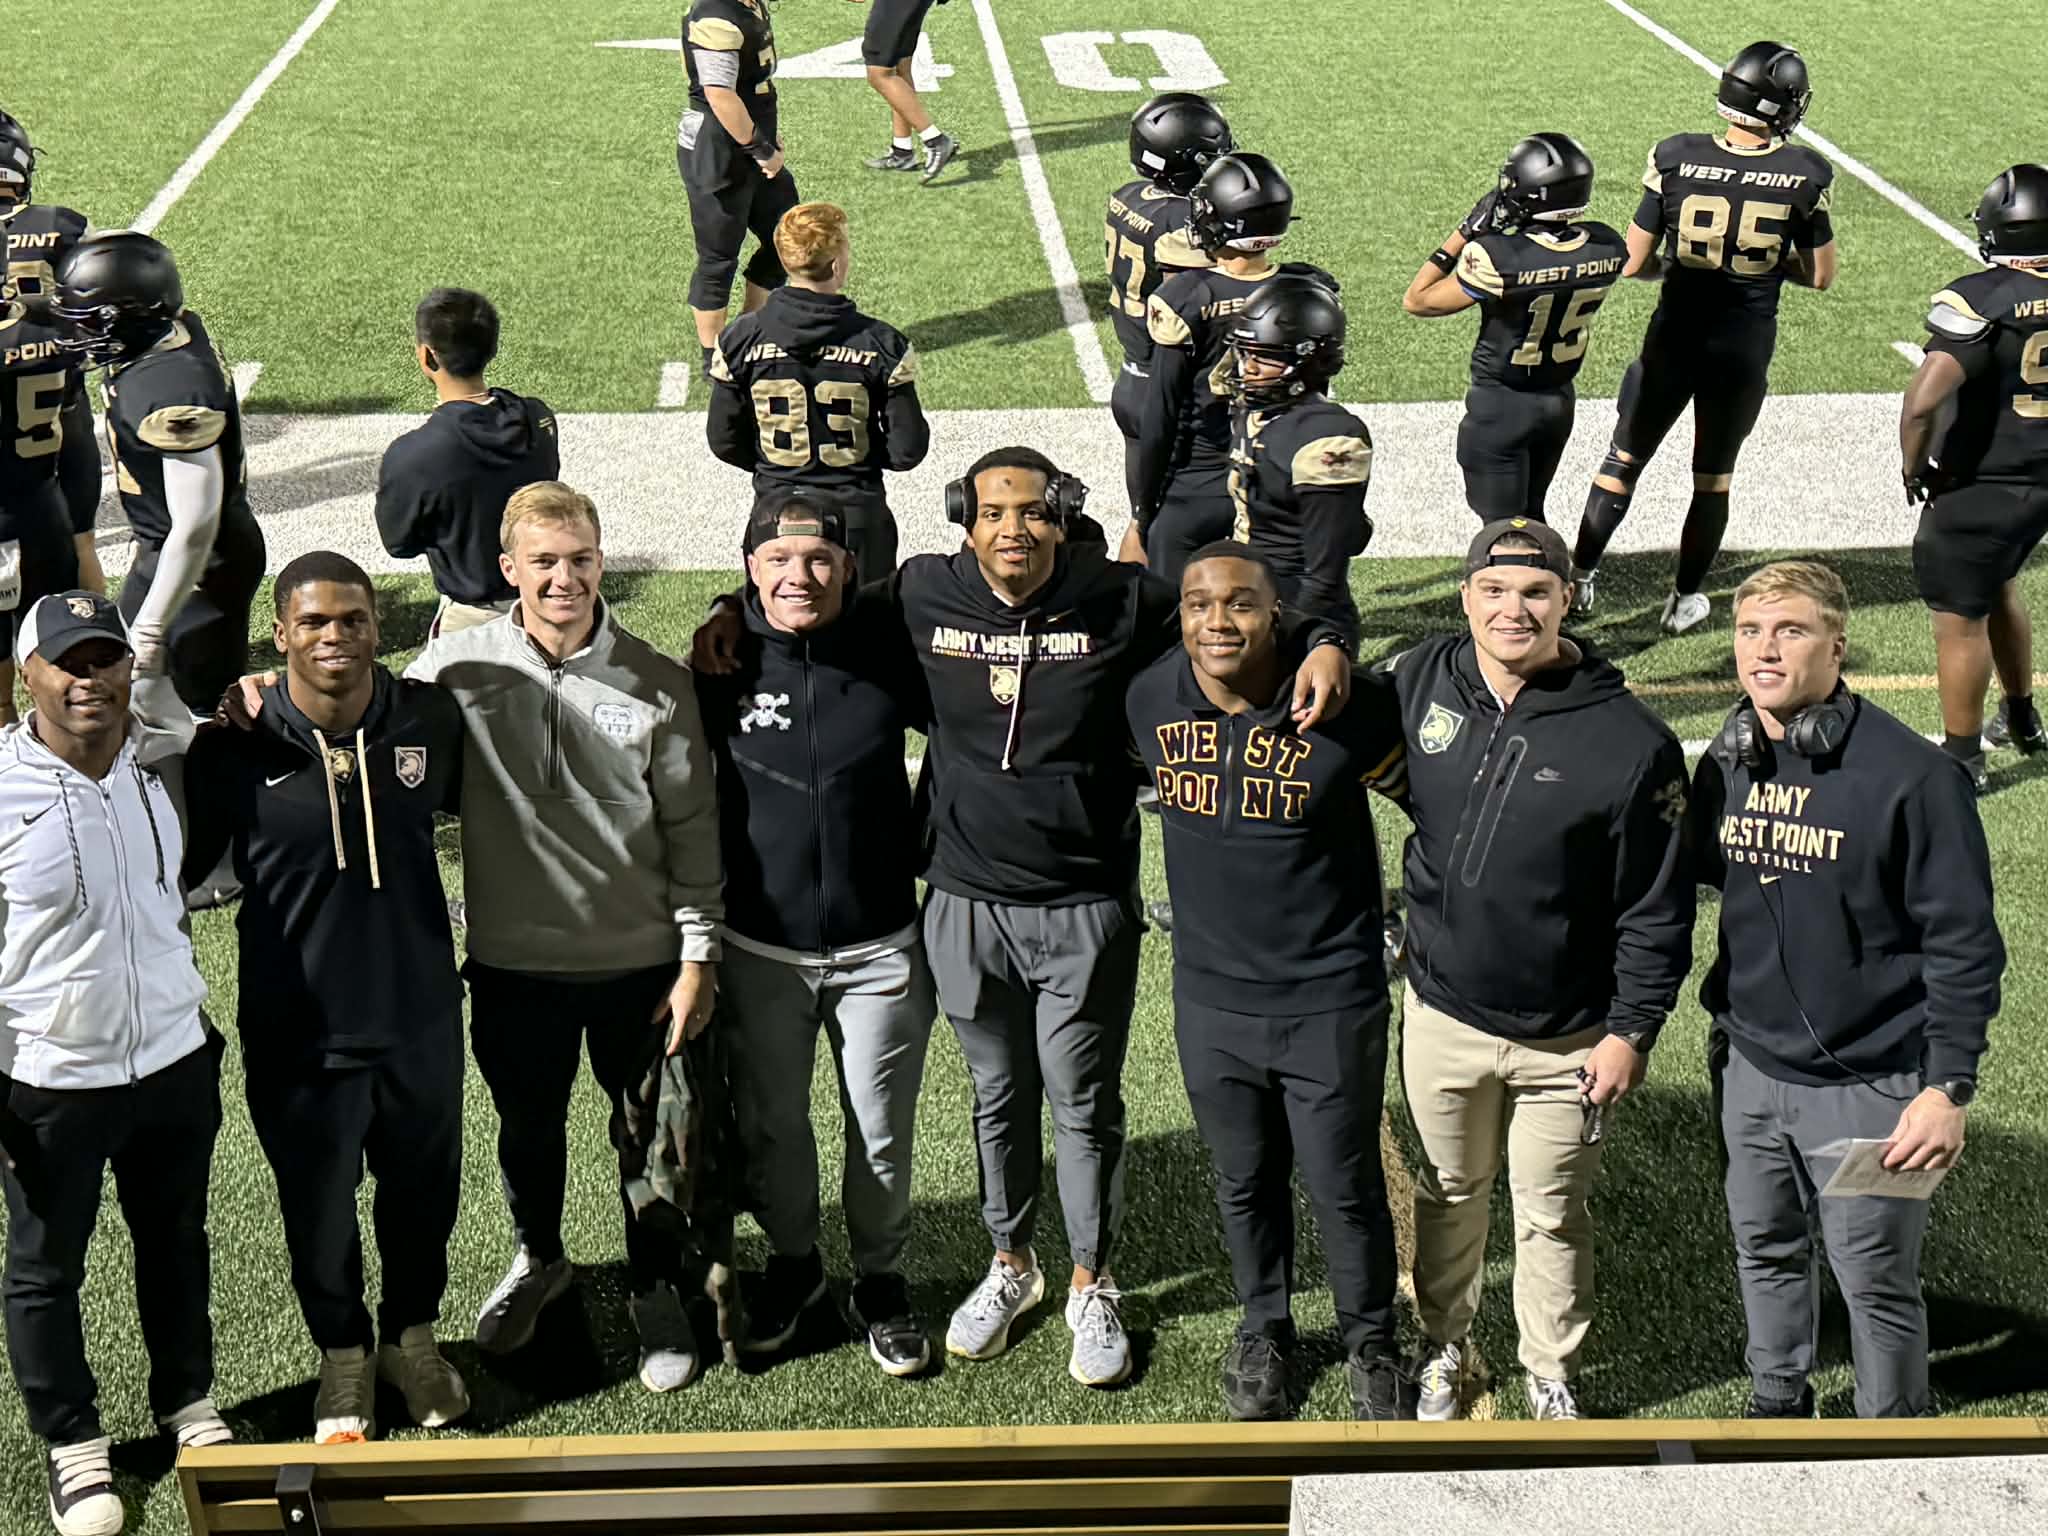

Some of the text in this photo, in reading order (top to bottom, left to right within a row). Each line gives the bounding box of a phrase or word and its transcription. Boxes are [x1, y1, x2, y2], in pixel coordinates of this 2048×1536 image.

[1678, 163, 1807, 189] WEST POINT
[1122, 210, 1154, 233] POINT
[1677, 194, 1792, 275] 85
[8, 231, 61, 248] OINT
[1517, 257, 1622, 285] WEST POINT
[1201, 297, 1245, 320] WES
[2014, 298, 2048, 319] WE
[1511, 287, 1610, 365] 15
[5, 338, 60, 366] POIN
[816, 345, 878, 366] OINT
[751, 378, 870, 467] 83
[931, 626, 979, 652] ARMY
[980, 633, 1033, 656] WEST
[1039, 631, 1090, 655] POINT
[1156, 720, 1312, 778] WEST
[1155, 765, 1311, 820] POINT
[1744, 781, 1812, 817] ARMY
[1719, 815, 1845, 861] WEST POINT
